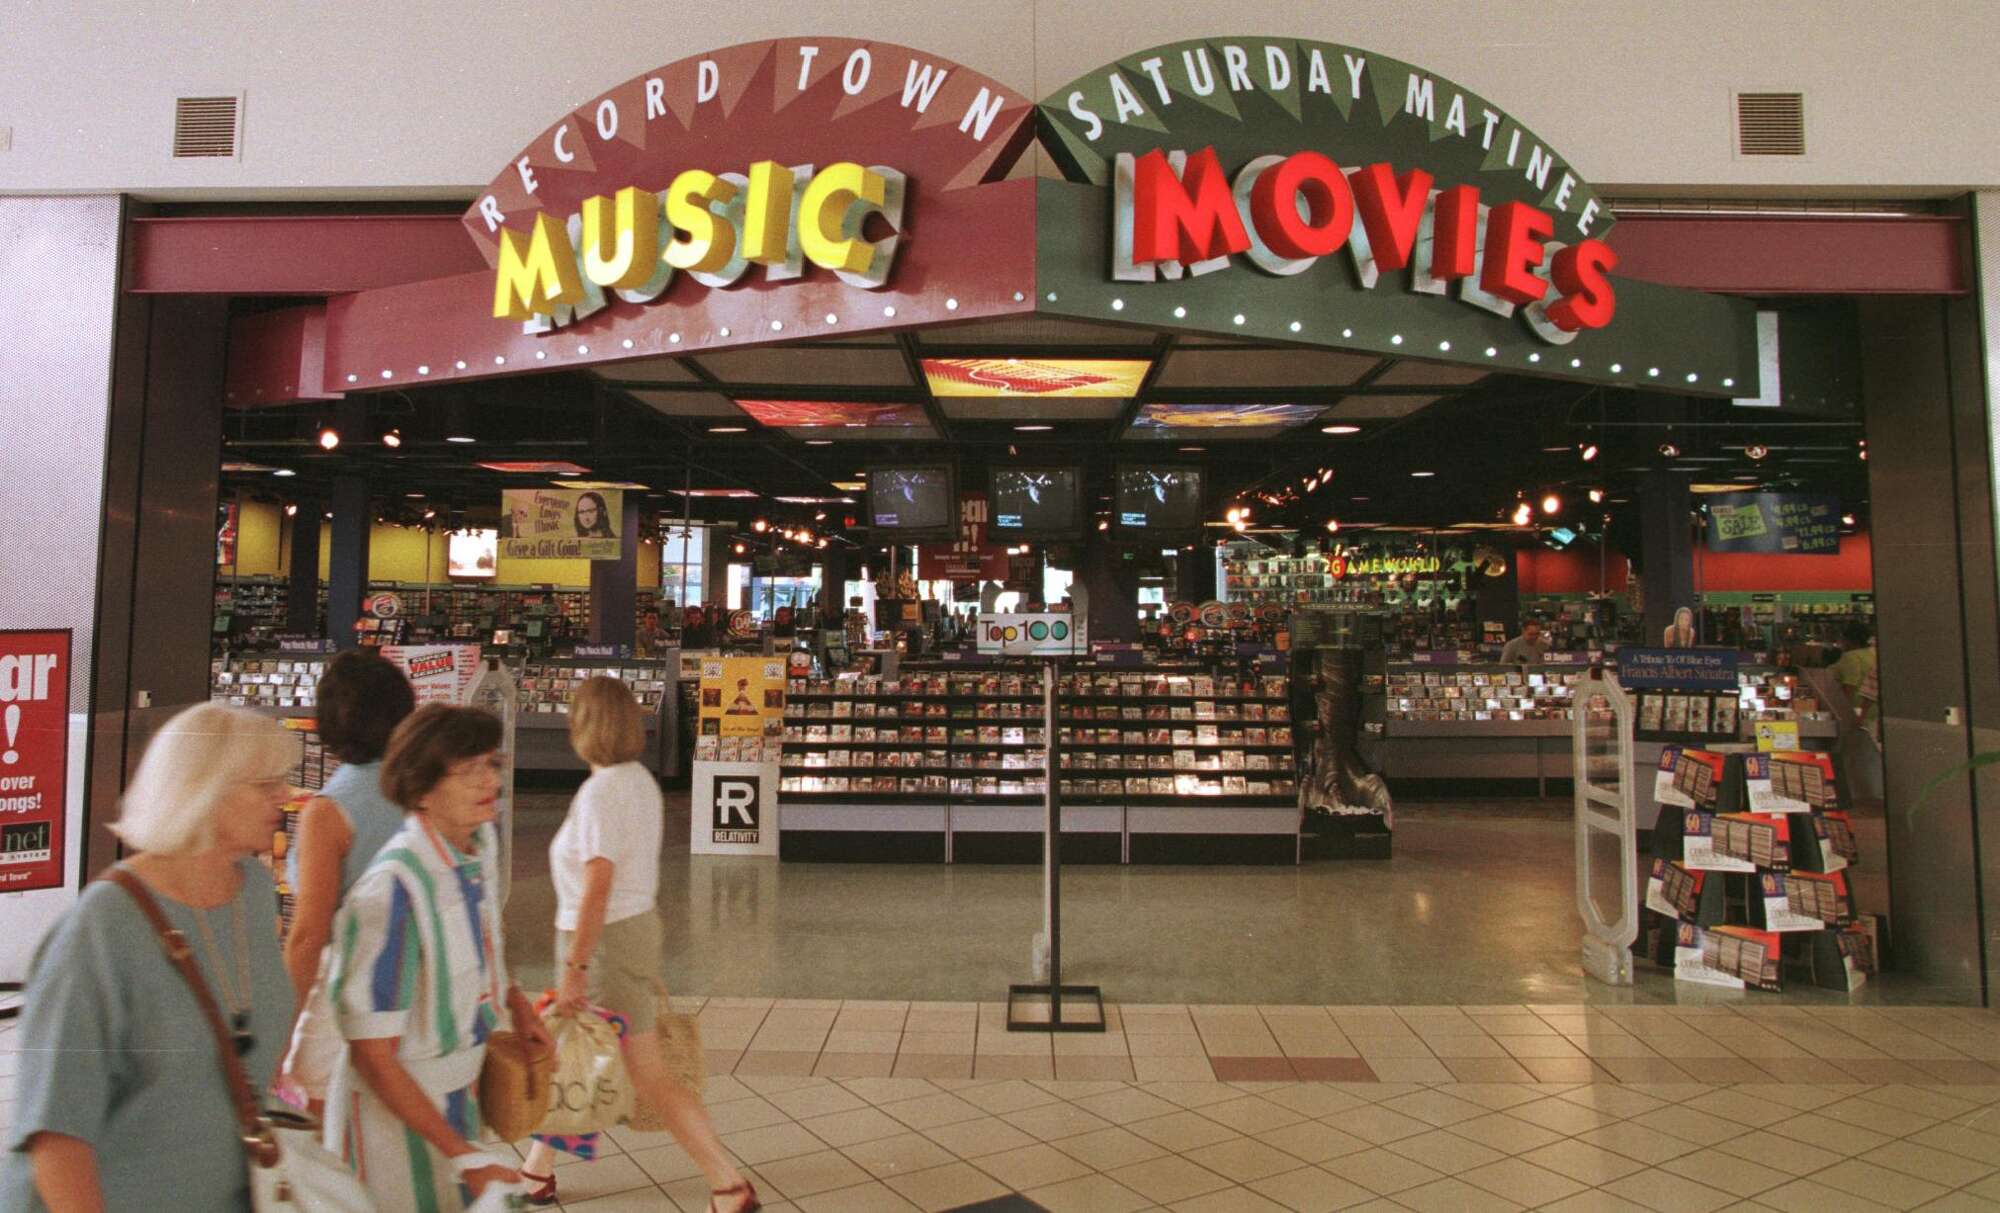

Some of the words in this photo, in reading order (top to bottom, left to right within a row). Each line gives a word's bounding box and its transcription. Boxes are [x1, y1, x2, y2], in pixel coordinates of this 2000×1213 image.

[478, 59, 720, 234] RECORD
[796, 44, 1005, 142] TOWN
[1067, 43, 1367, 142] SATURDAY
[1404, 72, 1600, 236] MATINEE
[492, 159, 886, 319] MUSIC
[1131, 144, 1618, 333] MOVIES
[980, 620, 1018, 648] Top
[1019, 620, 1069, 642] 100
[714, 831, 758, 843] RELATIVITY
[716, 782, 755, 825] R
